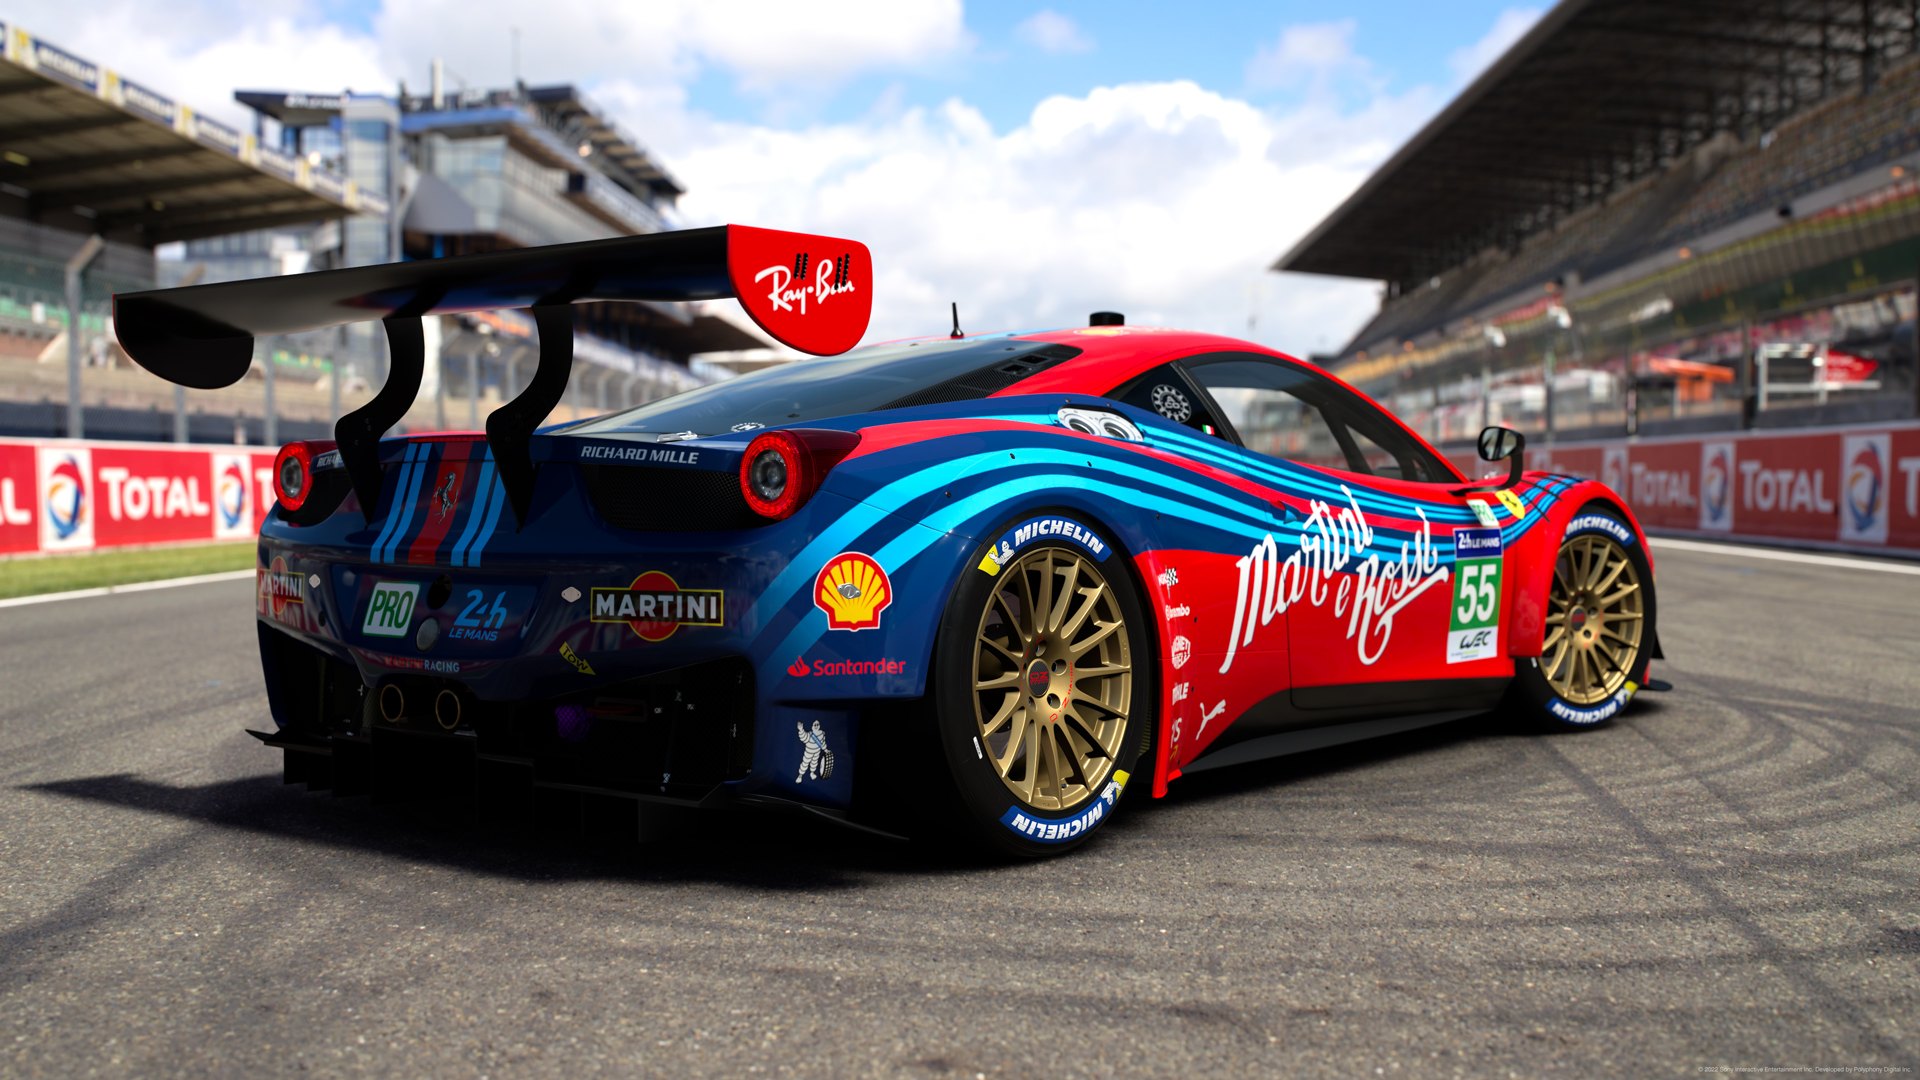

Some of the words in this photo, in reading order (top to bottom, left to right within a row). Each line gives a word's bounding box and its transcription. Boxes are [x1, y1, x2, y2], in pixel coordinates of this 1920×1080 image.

[581, 446, 648, 460] RICHARD
[649, 449, 699, 464] MILLE
[99, 467, 210, 521] TOTAL
[1630, 462, 1697, 507] TOTAL
[1740, 461, 1836, 513] TOTAL
[1014, 519, 1104, 554] MICHELIN
[1566, 516, 1630, 541] MICHELIN
[260, 574, 303, 598] MARTINI
[1457, 563, 1497, 624] 55
[367, 589, 414, 629] PRO
[596, 593, 718, 620] MARTINI
[448, 627, 464, 639] LE
[464, 629, 498, 641] MANS
[1459, 630, 1492, 649] WEC
[424, 660, 460, 673] RACING
[563, 646, 589, 671] TOW
[813, 658, 906, 677] Santander
[1552, 701, 1617, 724] MICHELIN
[1011, 802, 1103, 840] MICHELIN
